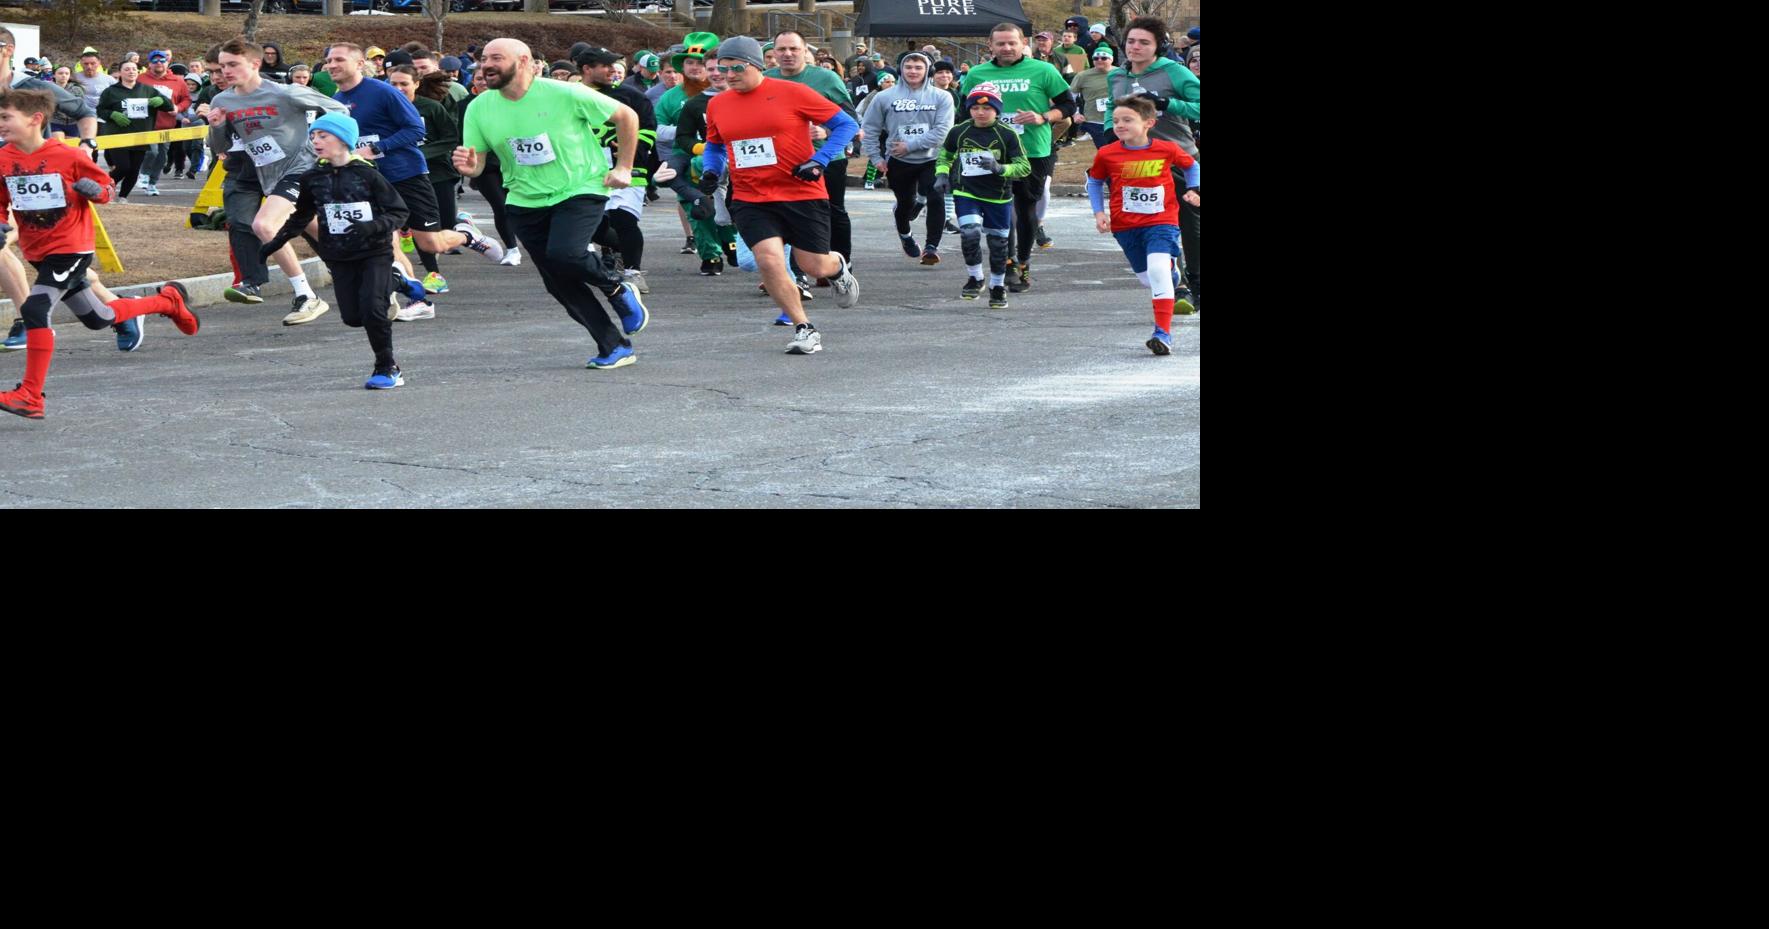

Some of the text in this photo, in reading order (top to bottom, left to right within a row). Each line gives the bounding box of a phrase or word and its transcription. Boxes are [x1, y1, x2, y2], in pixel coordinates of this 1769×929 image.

[992, 83, 1029, 93] QUAD
[904, 127, 925, 136] 445
[250, 142, 273, 156] 508
[516, 142, 544, 153] 470
[740, 144, 765, 155] 121
[1120, 159, 1166, 179] NIKE
[16, 182, 53, 195] 504
[1129, 192, 1158, 203] 505
[333, 209, 364, 221] 435
